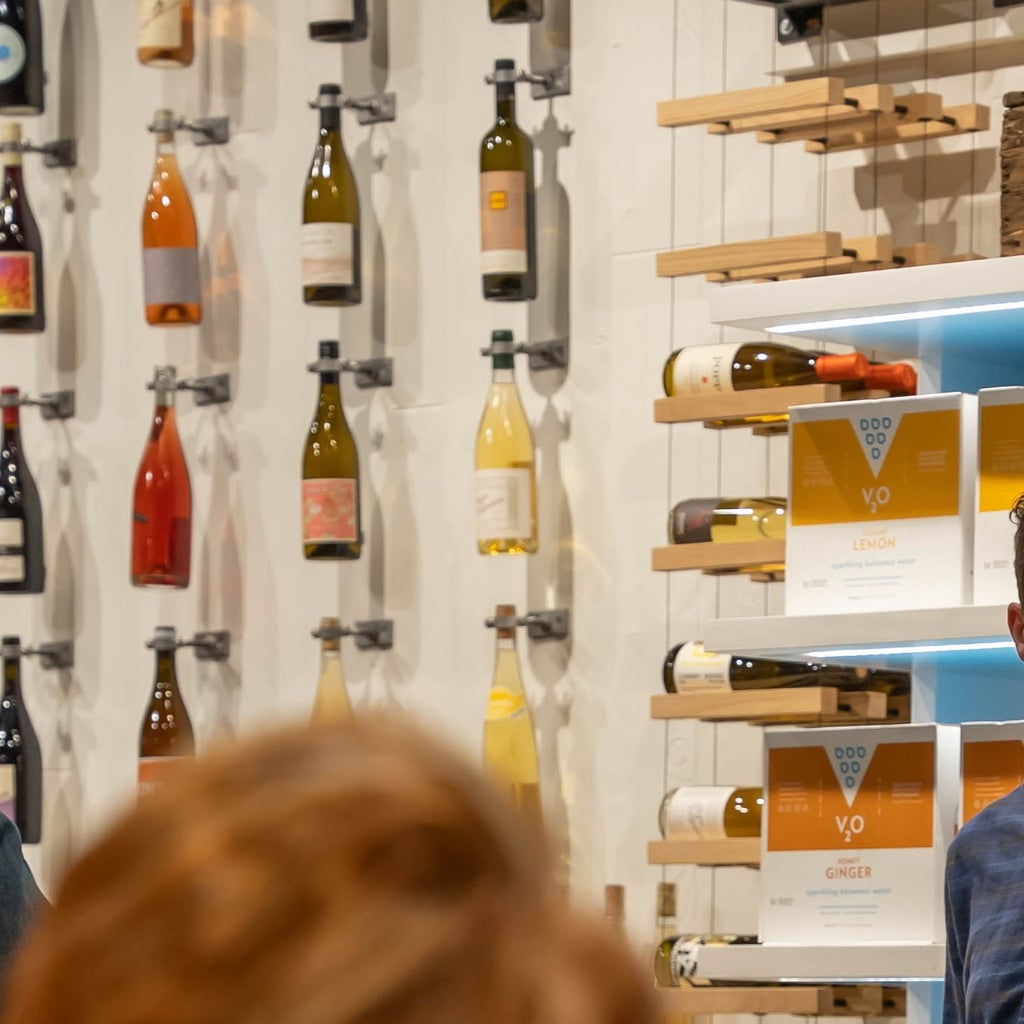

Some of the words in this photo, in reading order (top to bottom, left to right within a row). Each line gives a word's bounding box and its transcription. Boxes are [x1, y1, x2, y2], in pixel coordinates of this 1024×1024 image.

[861, 485, 891, 514] V2O
[853, 537, 896, 551] LEMON
[835, 814, 865, 843] V2O
[825, 866, 872, 879] GINGER
